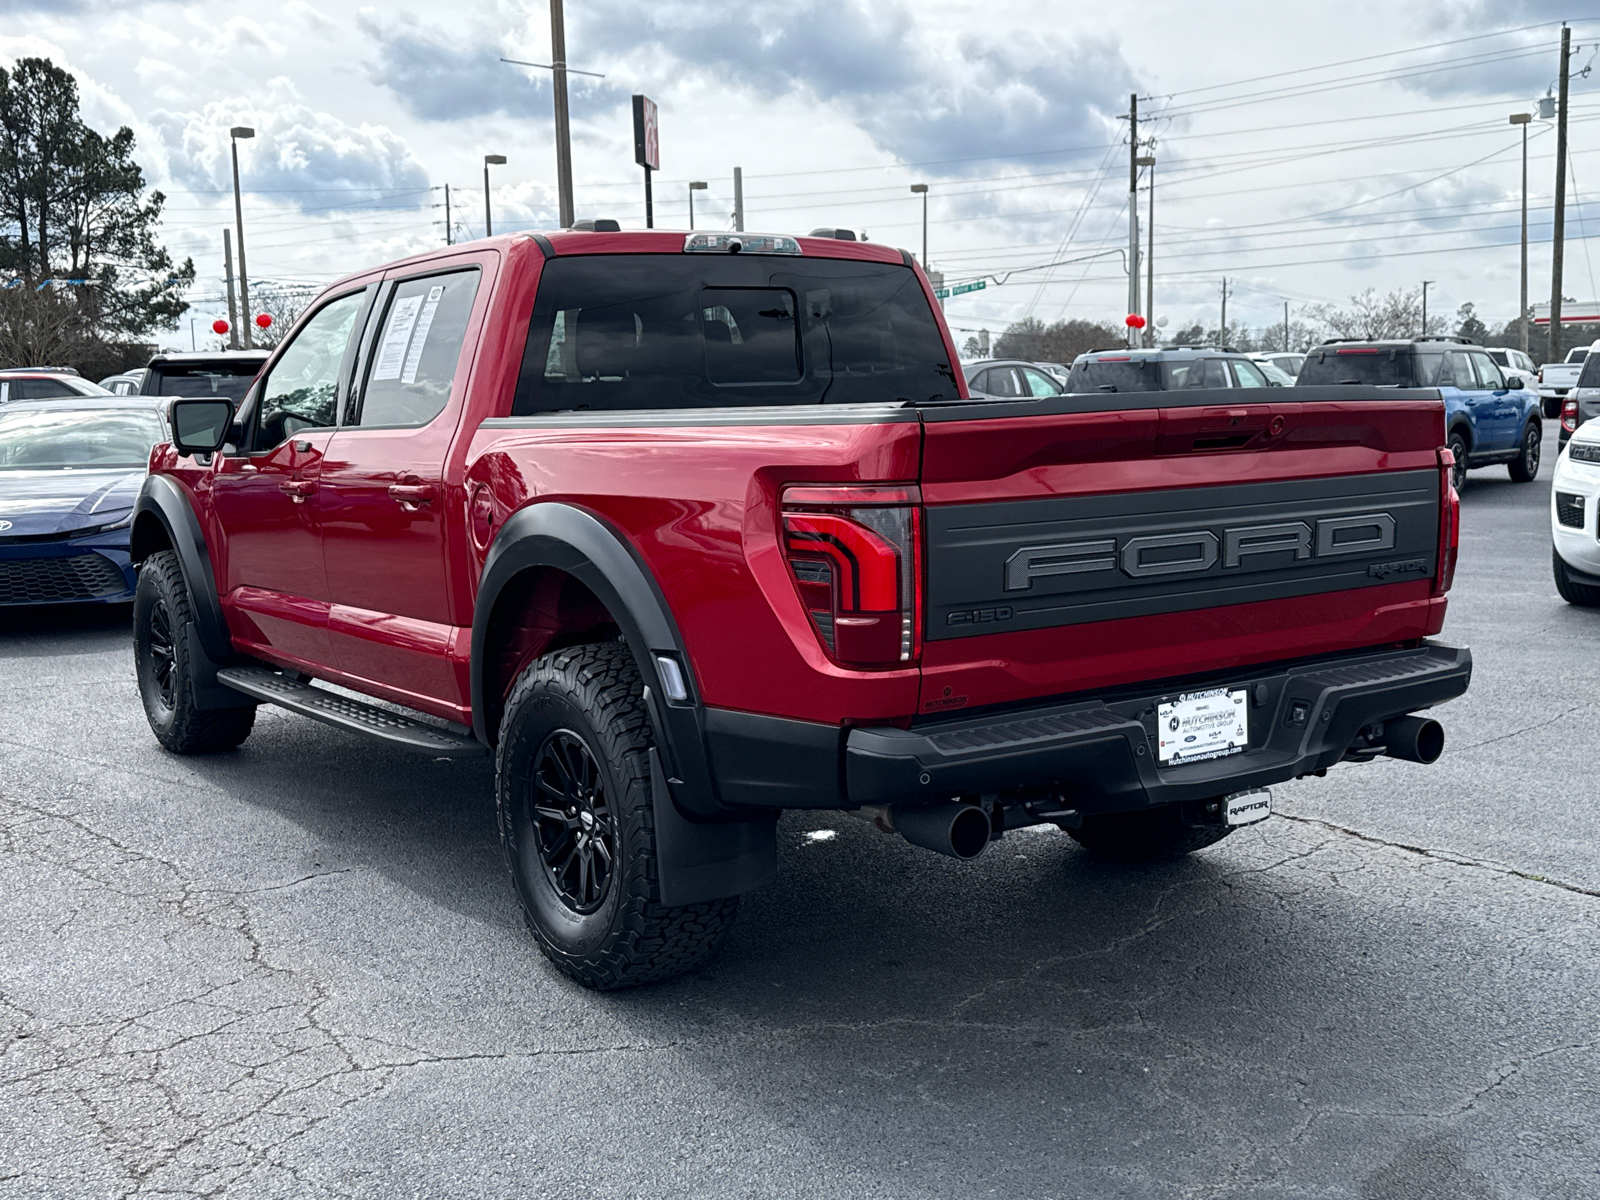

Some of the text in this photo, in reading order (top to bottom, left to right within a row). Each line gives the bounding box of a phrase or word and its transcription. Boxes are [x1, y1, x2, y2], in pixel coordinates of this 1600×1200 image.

[1005, 512, 1397, 591] FORD
[1368, 556, 1428, 580] RAPTOR
[946, 605, 1013, 627] F-150
[925, 695, 967, 708] HUTCHINSON
[1187, 687, 1228, 701] HUTCHINSON
[1181, 709, 1236, 728] HUTCHINSON
[1183, 719, 1234, 734] AUTOMOTIVE GROUP
[1169, 747, 1242, 766] Hutchinsonautogroup.com
[1229, 800, 1269, 816] RAPTOR
